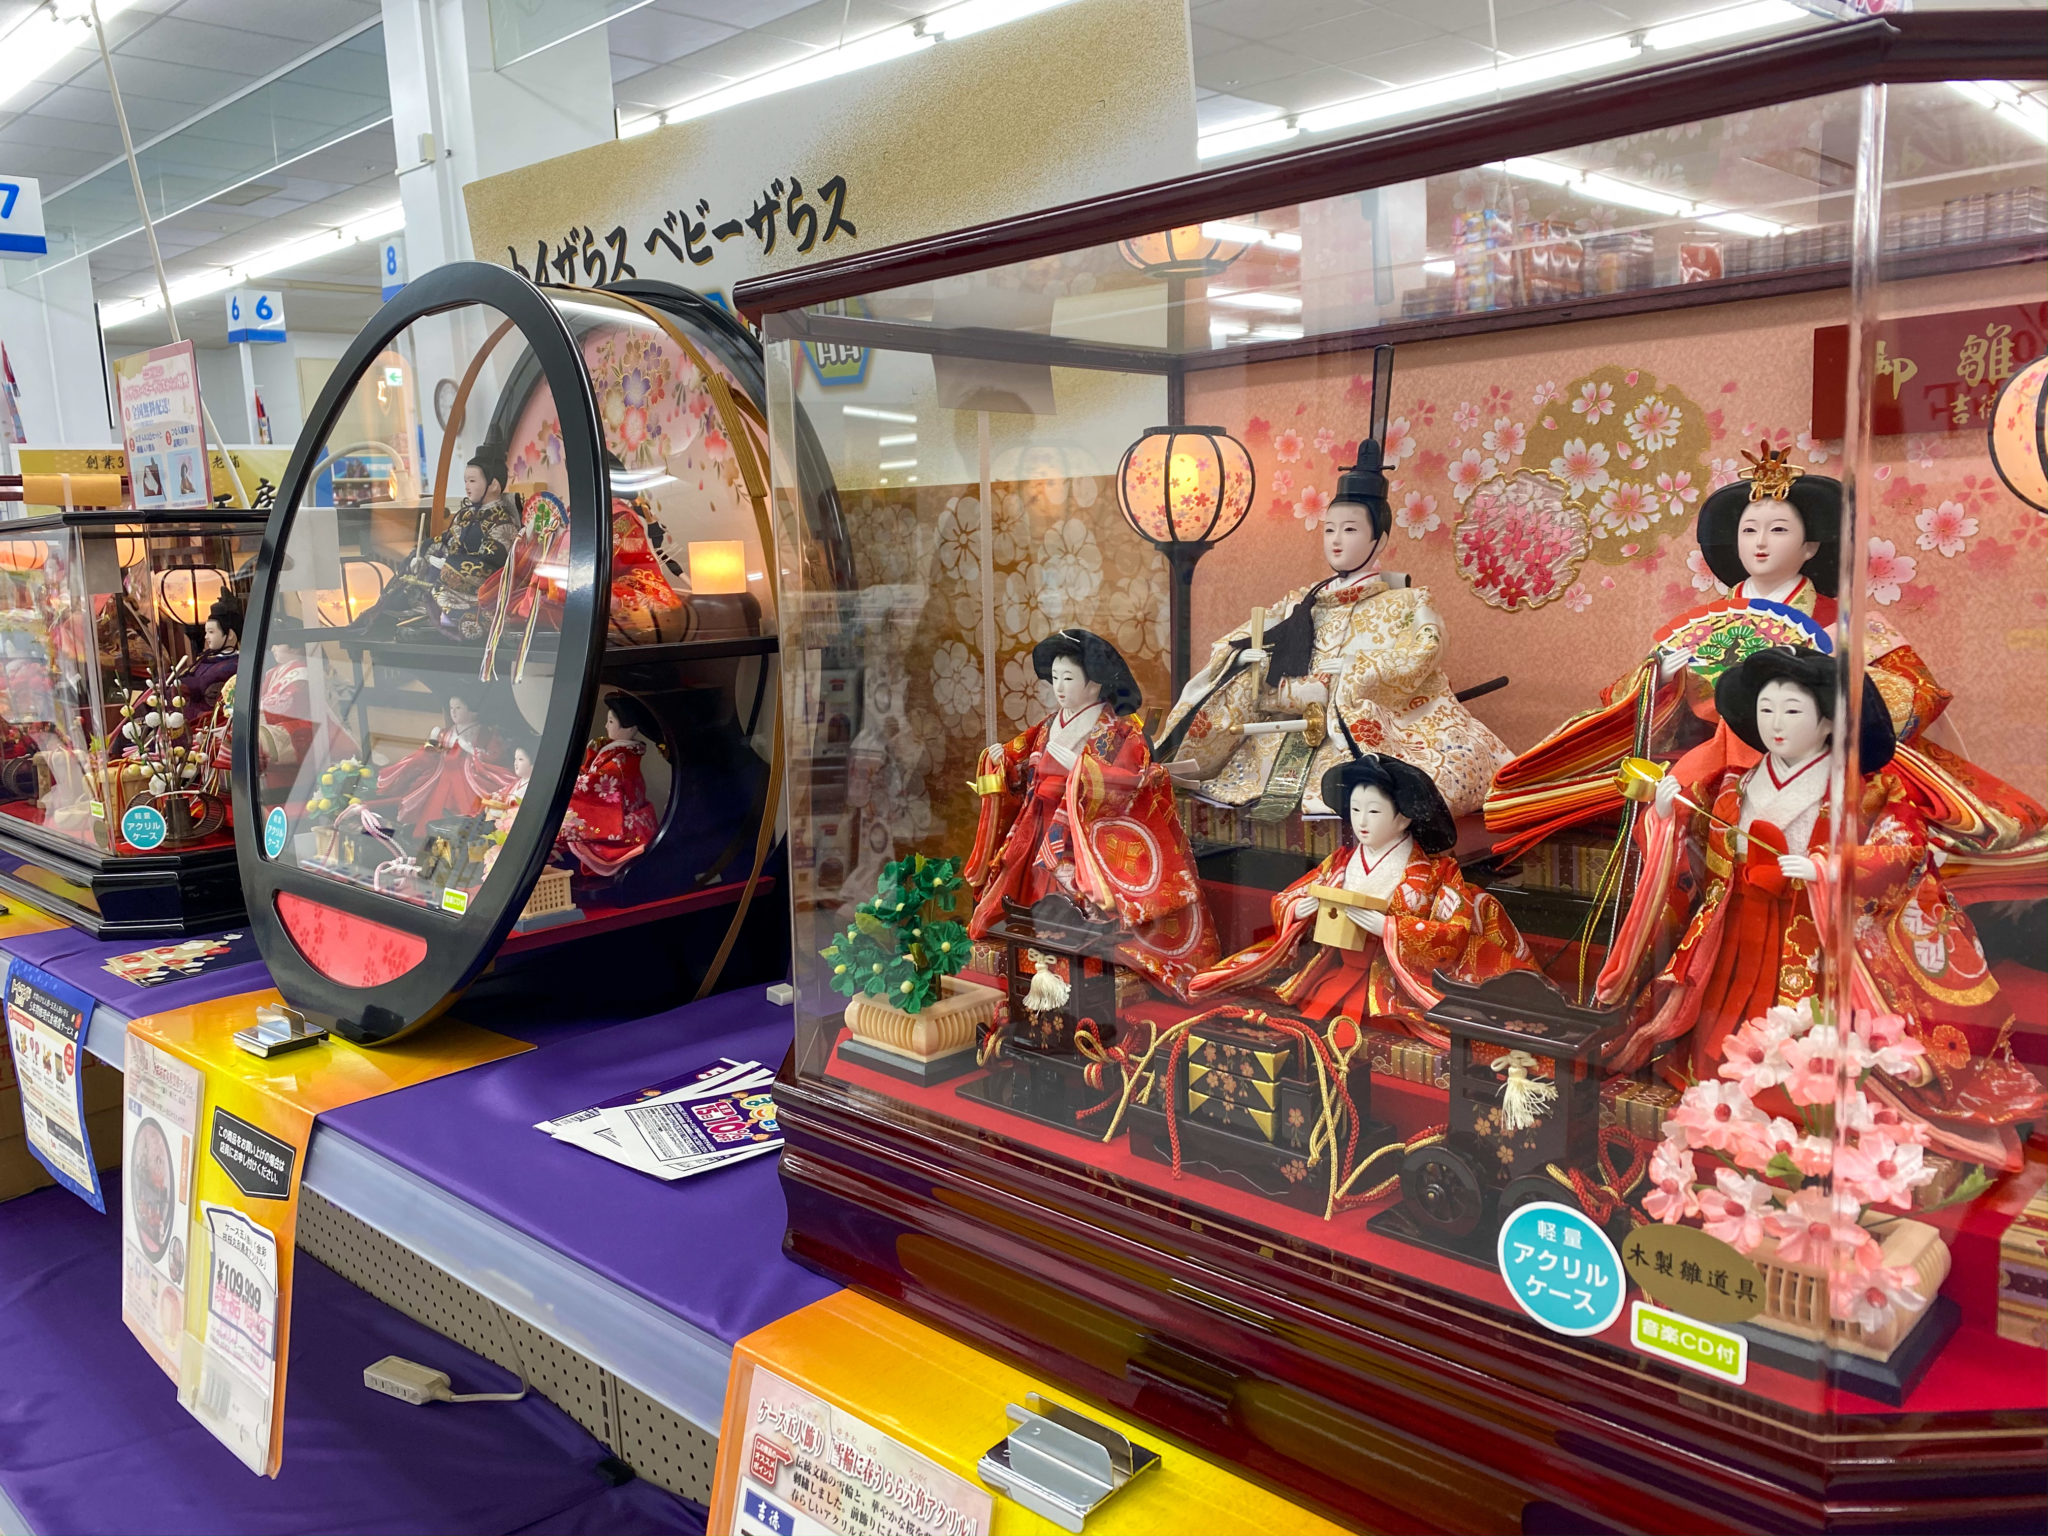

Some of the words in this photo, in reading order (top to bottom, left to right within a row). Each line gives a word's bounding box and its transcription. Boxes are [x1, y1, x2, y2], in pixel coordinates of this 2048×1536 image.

[0, 182, 20, 219] 7
[643, 174, 857, 264] ベビーザらス
[386, 245, 397, 275] 8
[231, 295, 240, 321] 6
[255, 295, 273, 321] 6
[127, 822, 161, 832] アクリル
[132, 832, 158, 841] ケース
[1537, 1219, 1583, 1250] 軽量
[1513, 1241, 1609, 1289] アクリル
[1626, 1243, 1759, 1304] 木製雛道具
[1525, 1274, 1597, 1316] ケース
[1641, 1318, 1736, 1366] 音楽CD付
